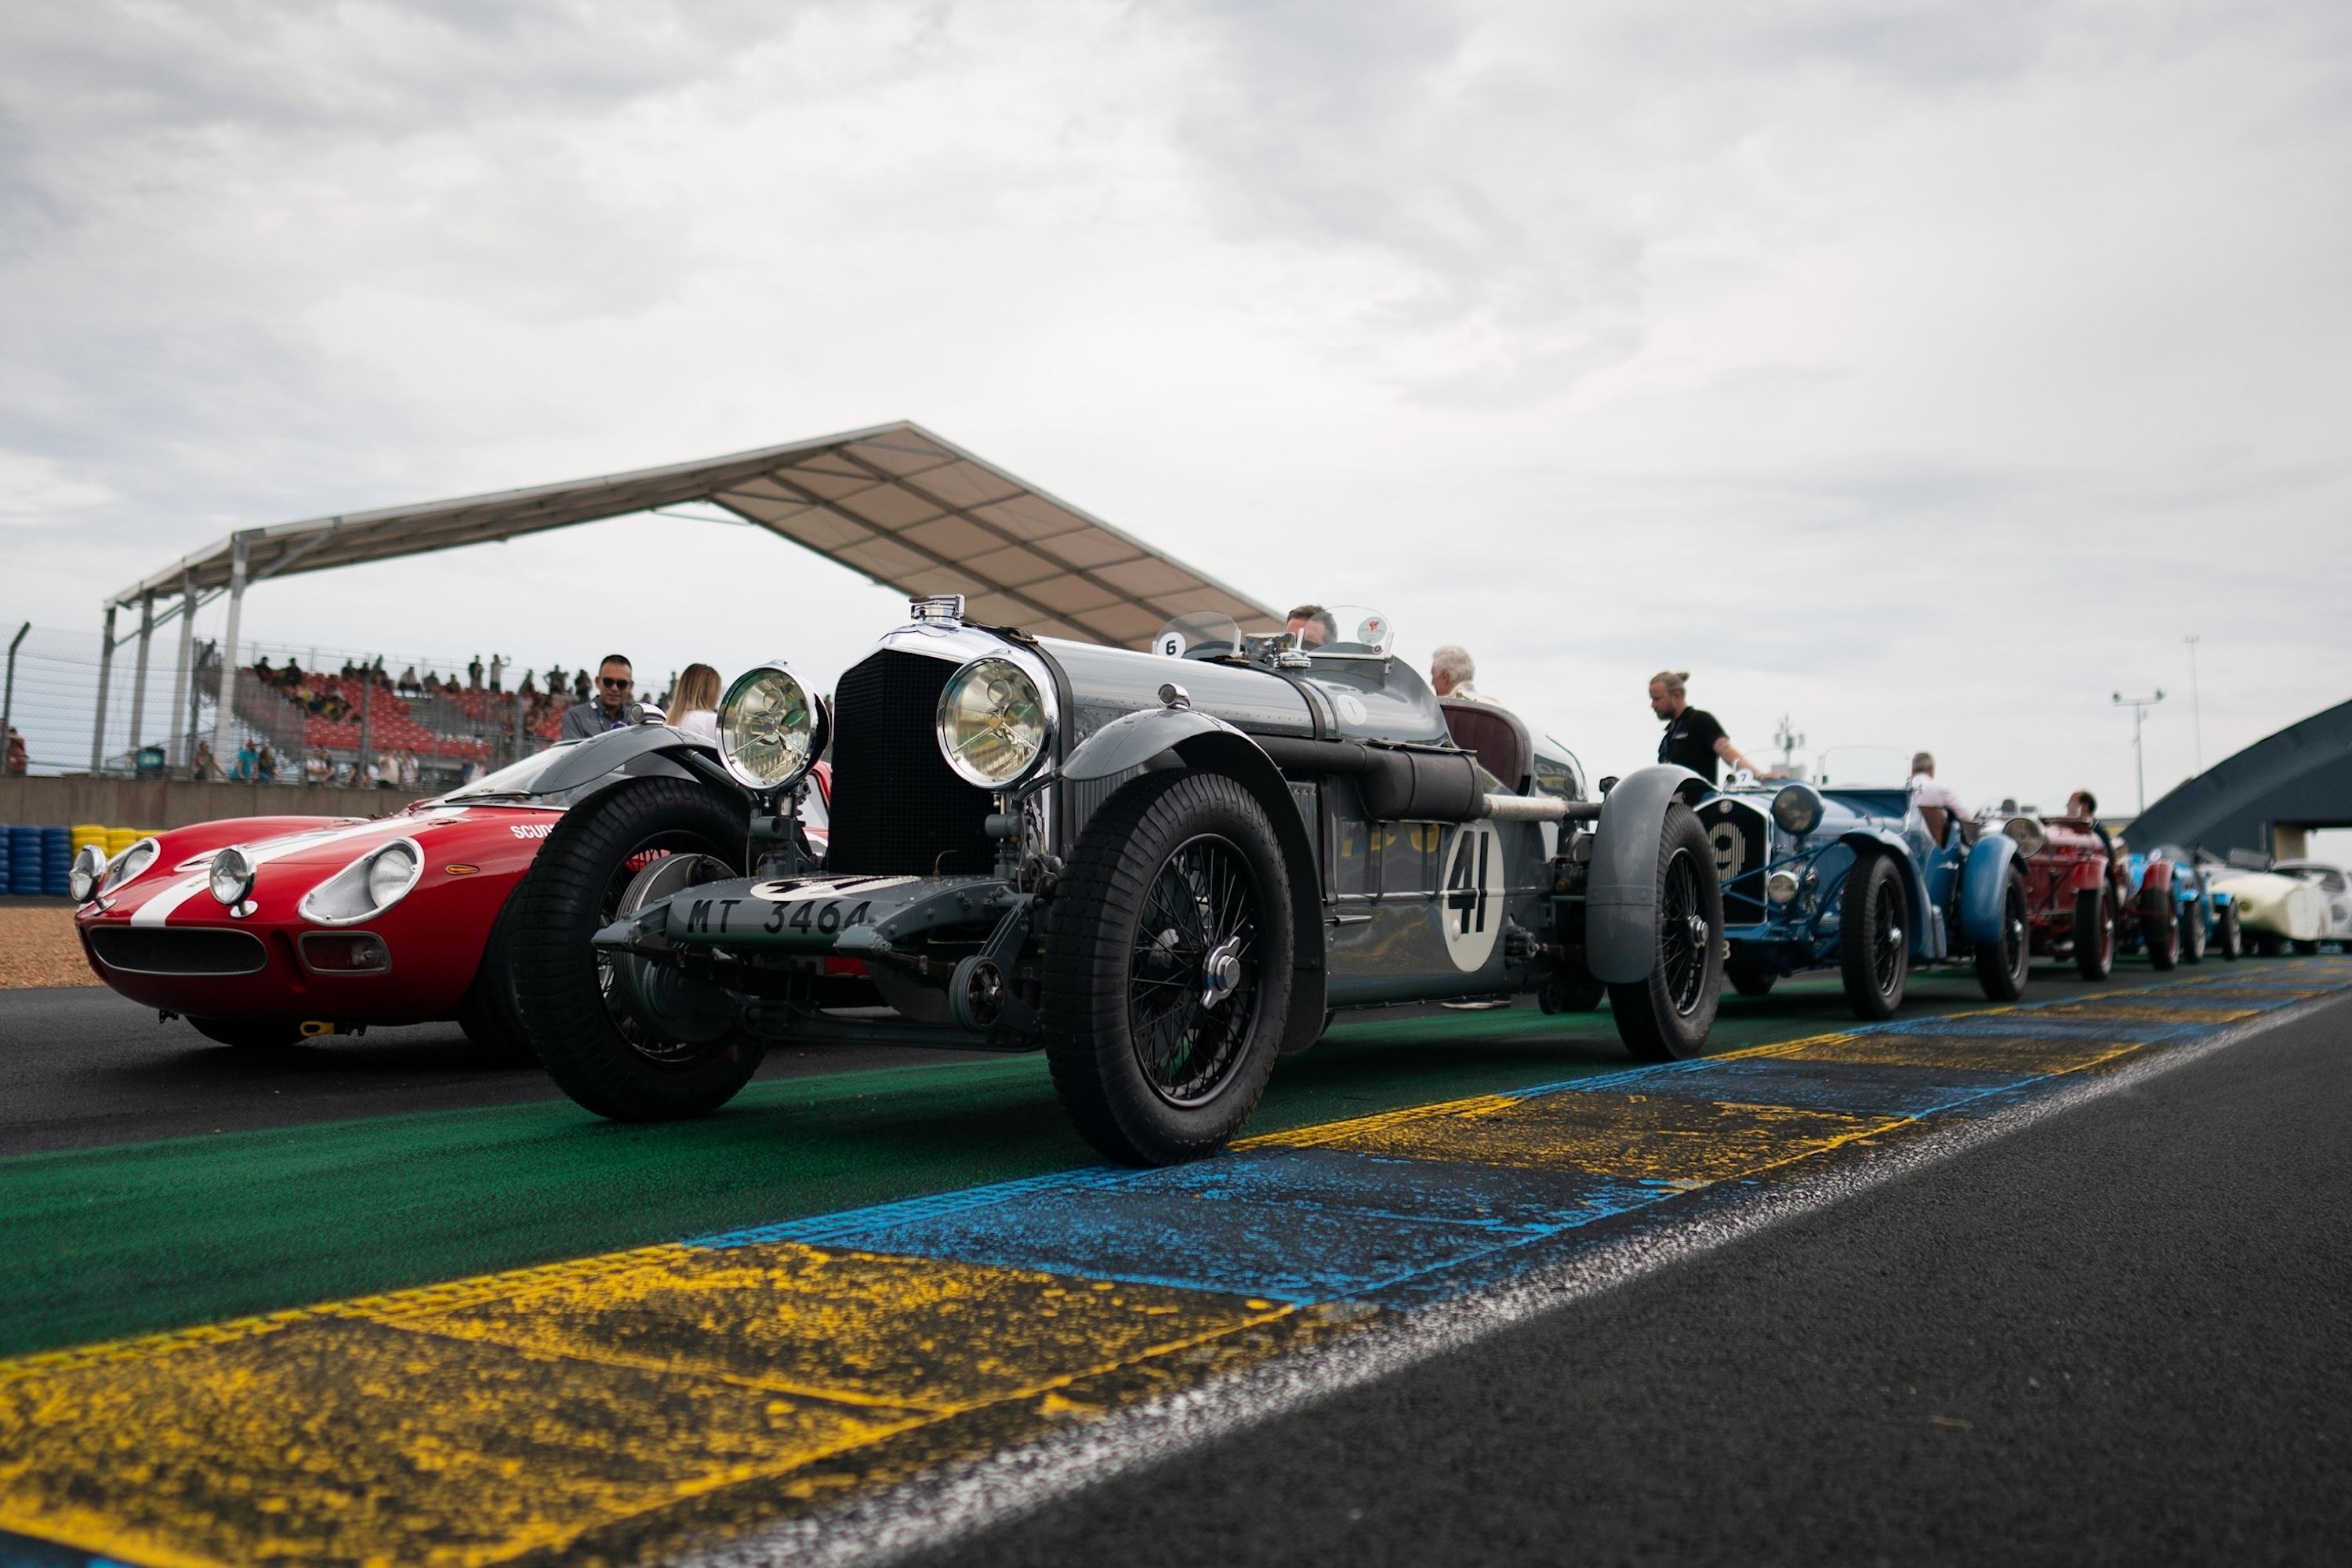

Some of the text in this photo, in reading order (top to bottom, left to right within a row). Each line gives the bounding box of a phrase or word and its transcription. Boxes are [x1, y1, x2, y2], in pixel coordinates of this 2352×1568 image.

[1166, 640, 1176, 655] 6
[510, 824, 555, 839] SCUD
[1708, 822, 1746, 891] 9
[1447, 831, 1489, 935] 41
[687, 899, 873, 935] MT 3464
